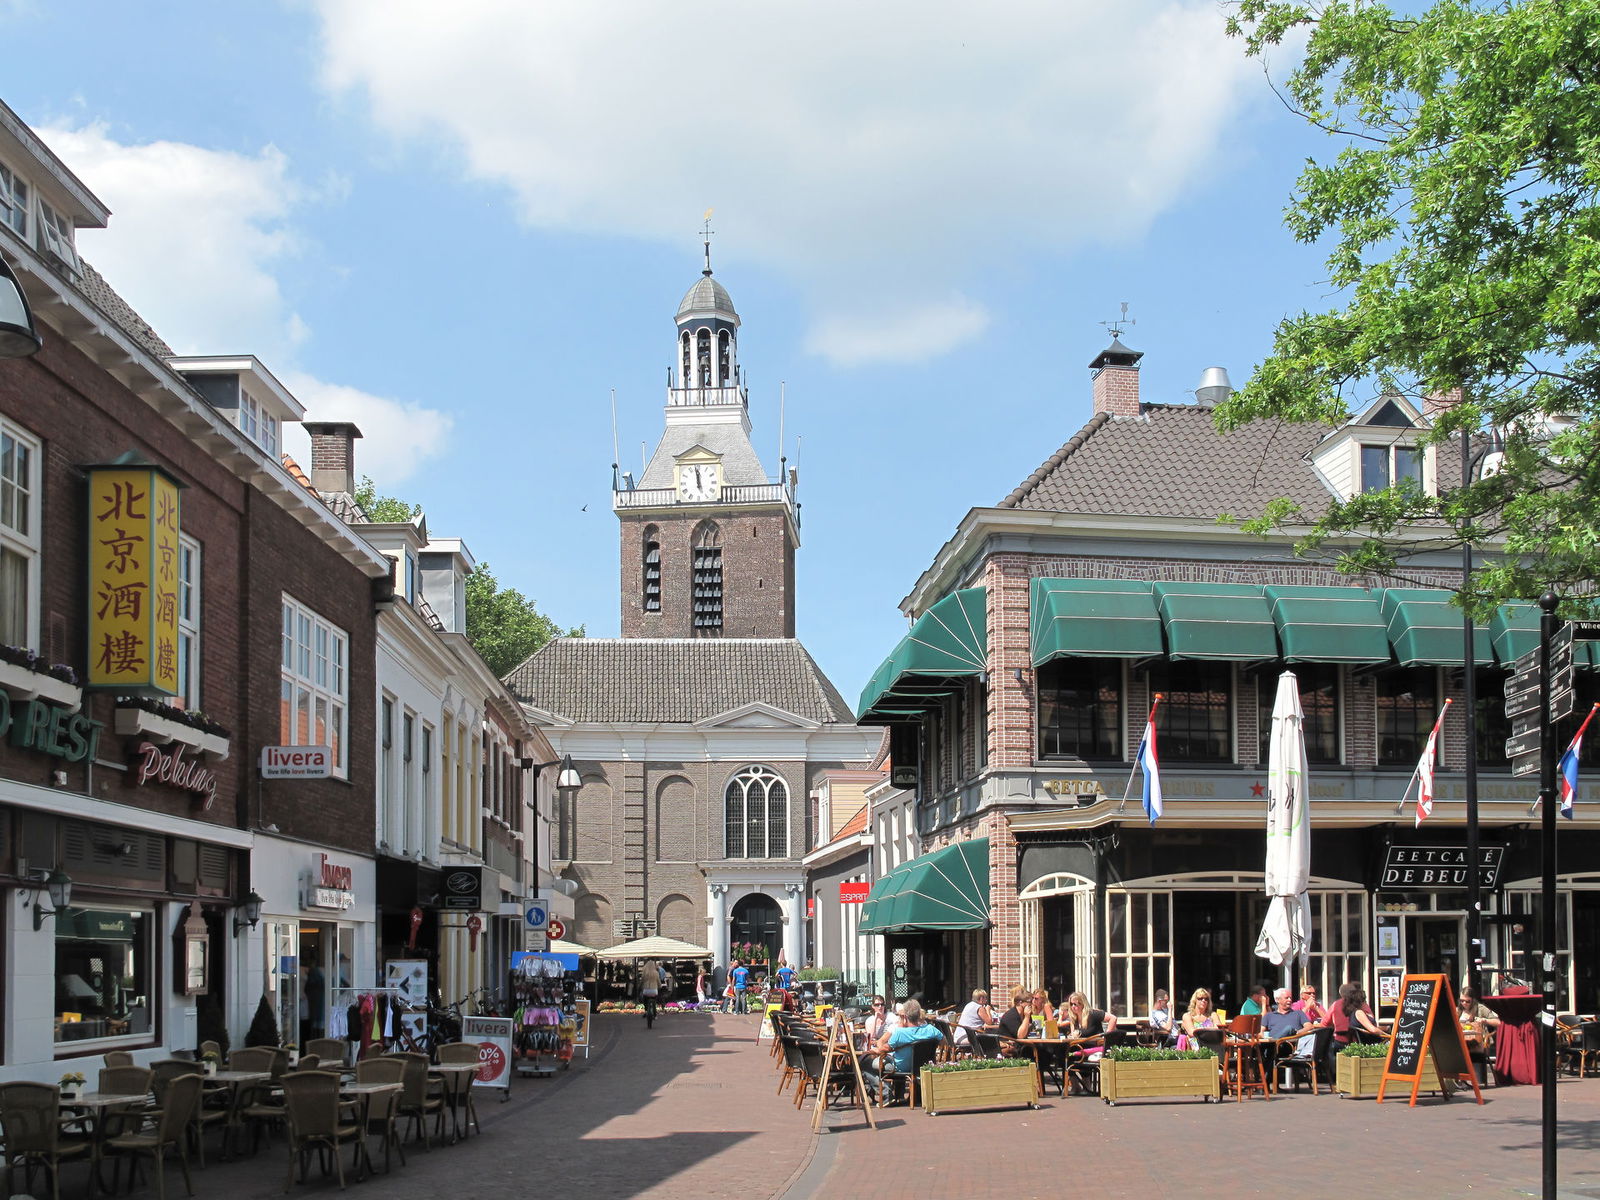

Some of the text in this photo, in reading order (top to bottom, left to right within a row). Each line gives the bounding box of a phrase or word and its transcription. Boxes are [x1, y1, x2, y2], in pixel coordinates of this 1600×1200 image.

[96, 481, 148, 675] 北京酒樓
[156, 489, 176, 681] 北京酒樓
[23, 699, 105, 763] REST
[268, 748, 324, 766] livera
[1396, 850, 1494, 863] EETCAÉ
[1385, 869, 1495, 884] DE BEUS
[841, 892, 868, 901] ESPRIT
[467, 1020, 508, 1034] livera
[479, 1047, 499, 1060] 0%
